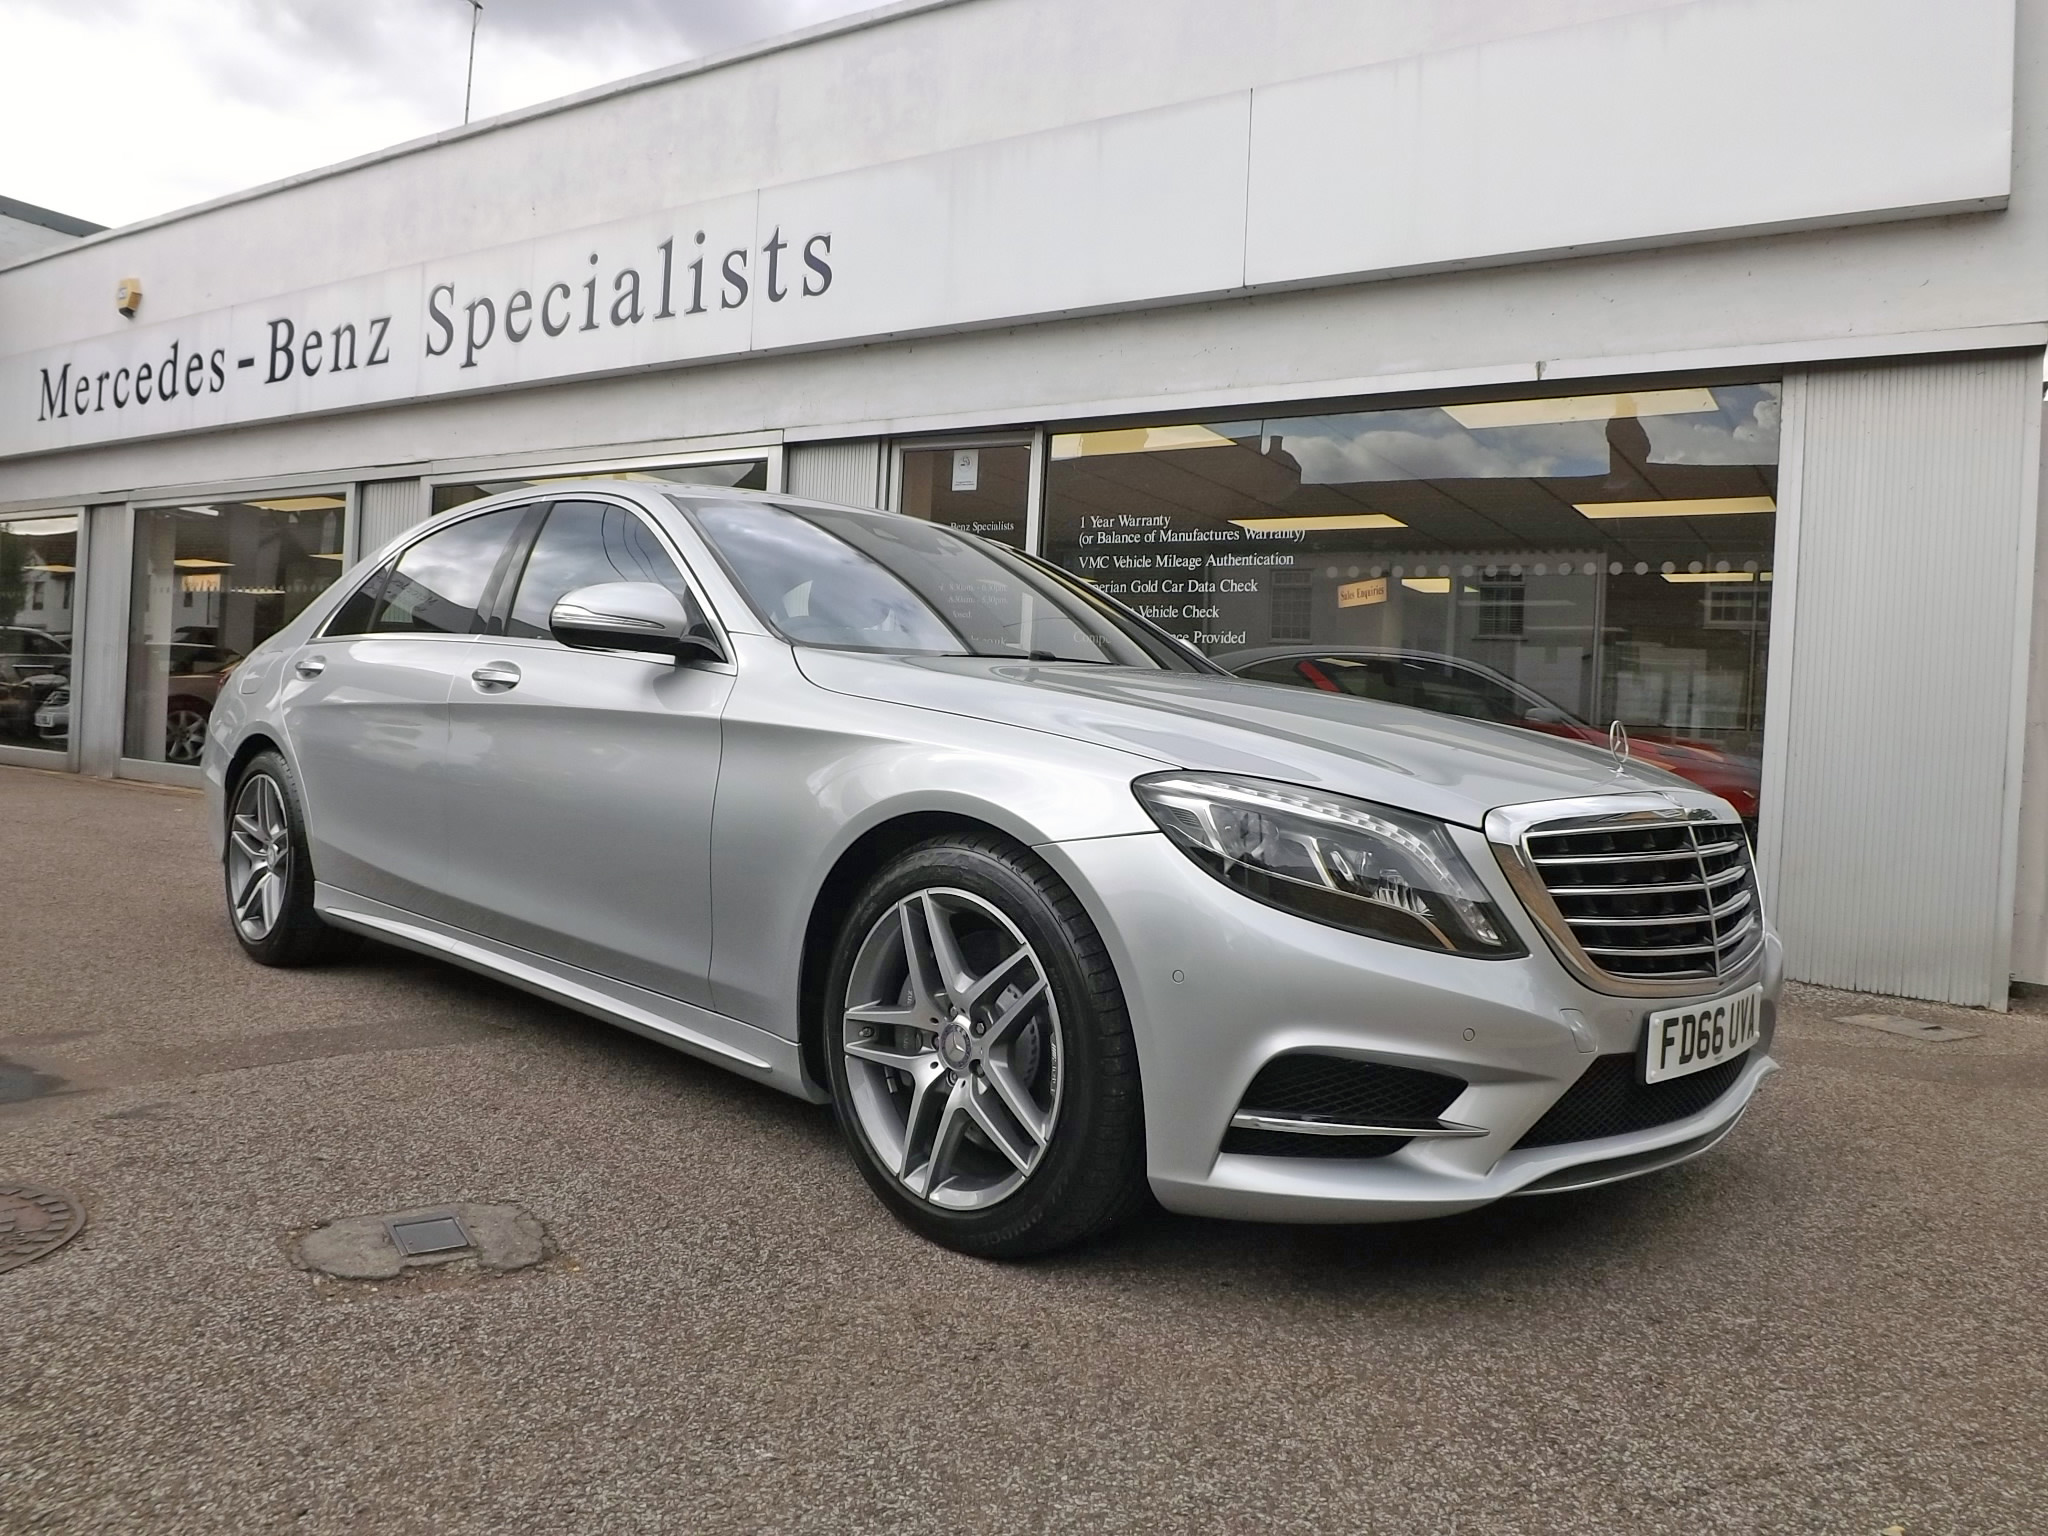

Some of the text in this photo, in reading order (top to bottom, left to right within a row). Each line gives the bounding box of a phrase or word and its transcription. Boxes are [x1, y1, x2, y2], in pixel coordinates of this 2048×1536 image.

[37, 225, 833, 422] Mercedes-Benz Specialists
[972, 520, 1015, 534] Specialists
[1080, 514, 1171, 529] 1 Year Warranty
[1078, 533, 1093, 548] (or
[1097, 531, 1141, 544] Balance
[1144, 530, 1156, 543] of
[1159, 527, 1240, 542] Manufactures
[1078, 552, 1294, 570] VMC Vehicle Mileage Authentication
[1130, 578, 1158, 593] Gold
[1161, 579, 1184, 592] Car
[1187, 579, 1216, 592] Data
[1220, 577, 1258, 592] Check
[1356, 585, 1385, 599] Enquiries
[1138, 604, 1220, 618] Vehicle Check
[1193, 631, 1246, 644] Provided
[1660, 994, 1755, 1070] FD66 UVA
